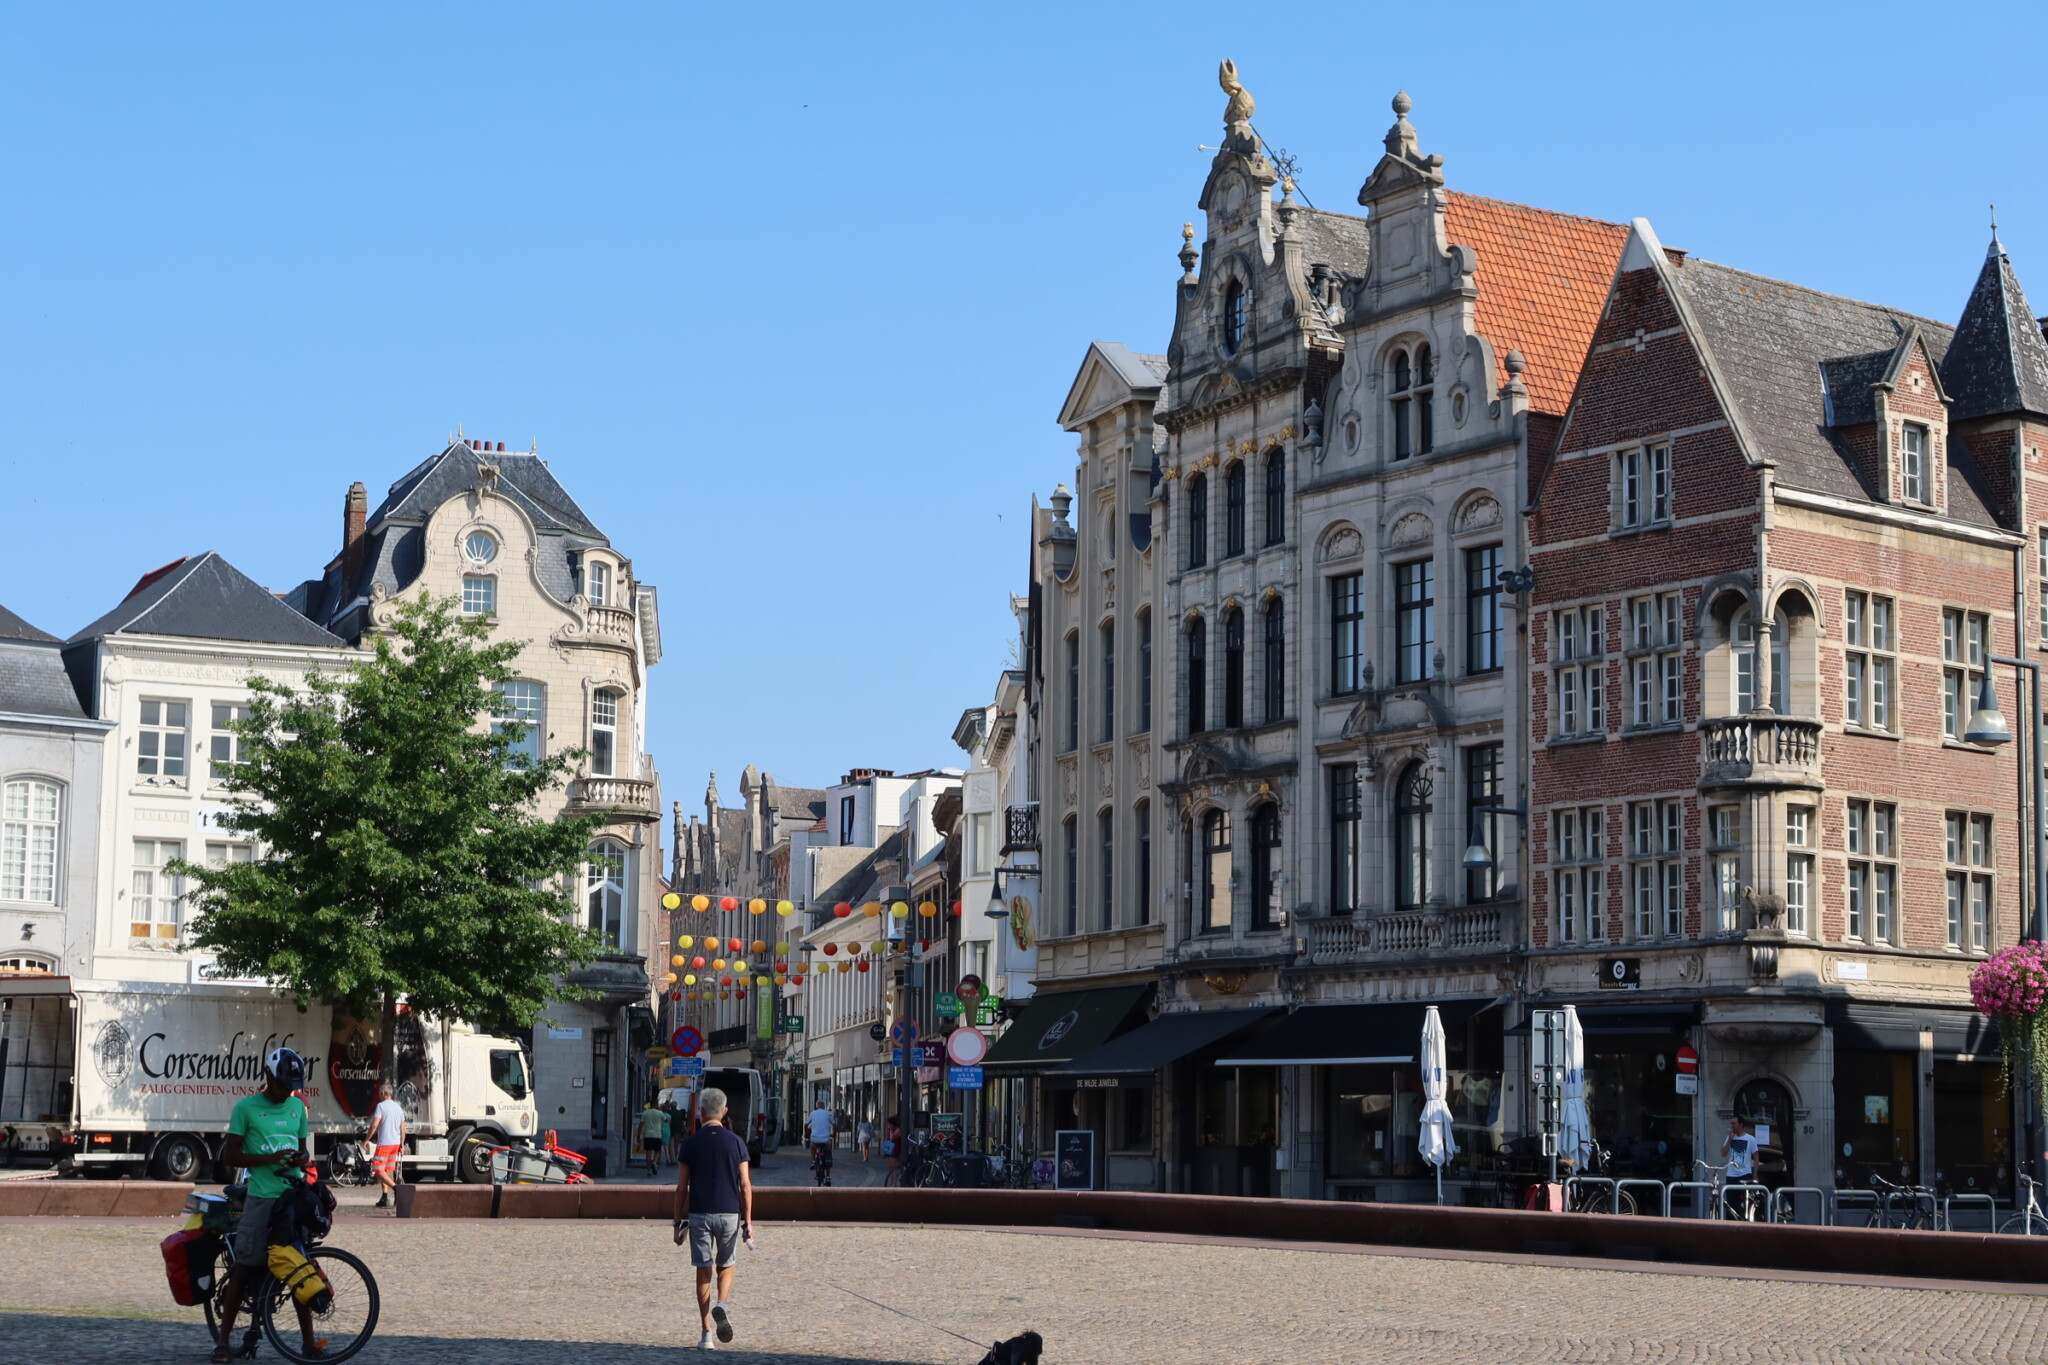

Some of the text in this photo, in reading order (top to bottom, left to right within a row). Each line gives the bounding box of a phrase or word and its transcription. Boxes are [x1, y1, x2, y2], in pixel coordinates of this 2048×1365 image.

[1076, 1078, 1119, 1088] DE WILDE JUWELEN
[140, 1083, 172, 1094] ZALIG
[173, 1084, 225, 1095] GENIETEN
[231, 1086, 248, 1096] UN
[451, 1106, 457, 1115] 6
[1803, 1126, 1814, 1134] 50
